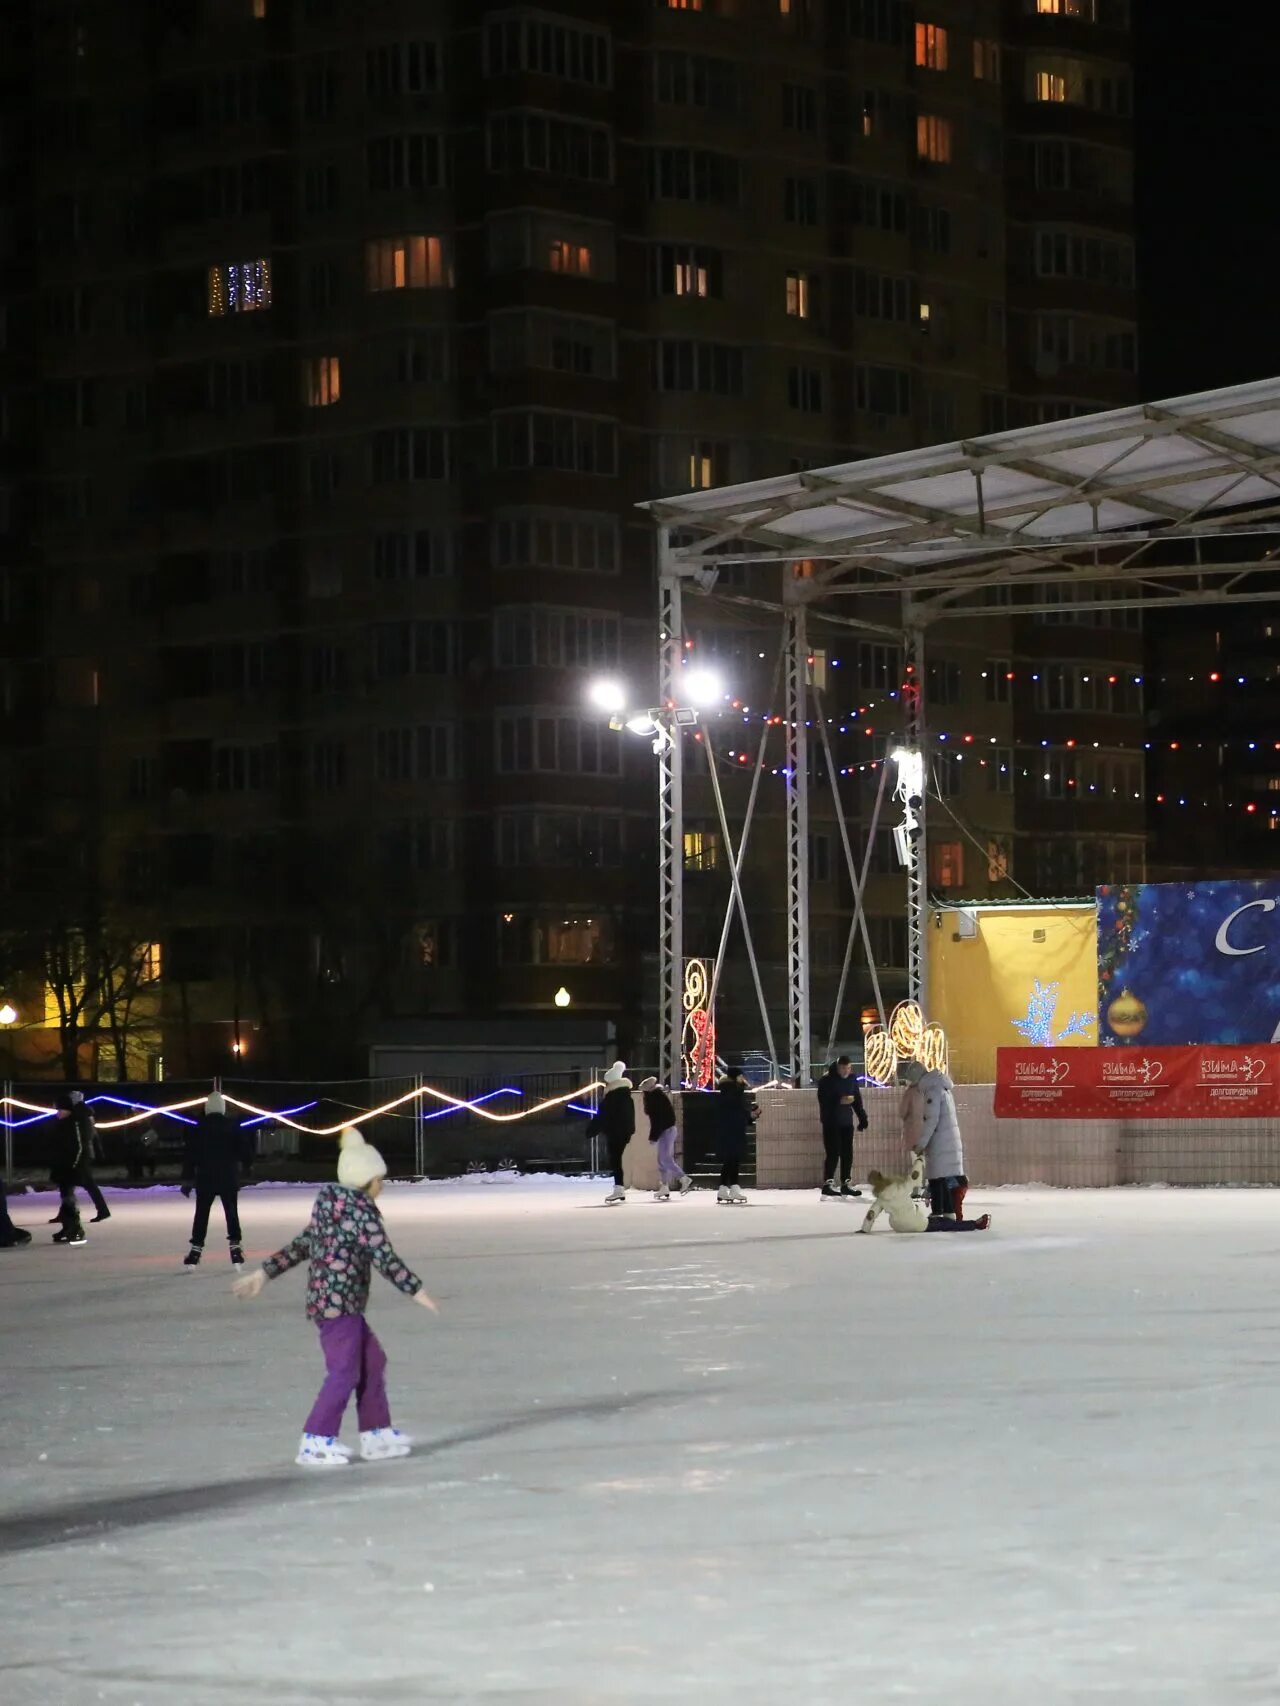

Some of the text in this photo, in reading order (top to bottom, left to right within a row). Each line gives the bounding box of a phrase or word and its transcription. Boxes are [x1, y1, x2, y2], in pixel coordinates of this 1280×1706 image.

[1215, 899, 1276, 956] С
[1103, 1062, 1136, 1075] ЗИМА
[1201, 1060, 1238, 1073] ЗИМА
